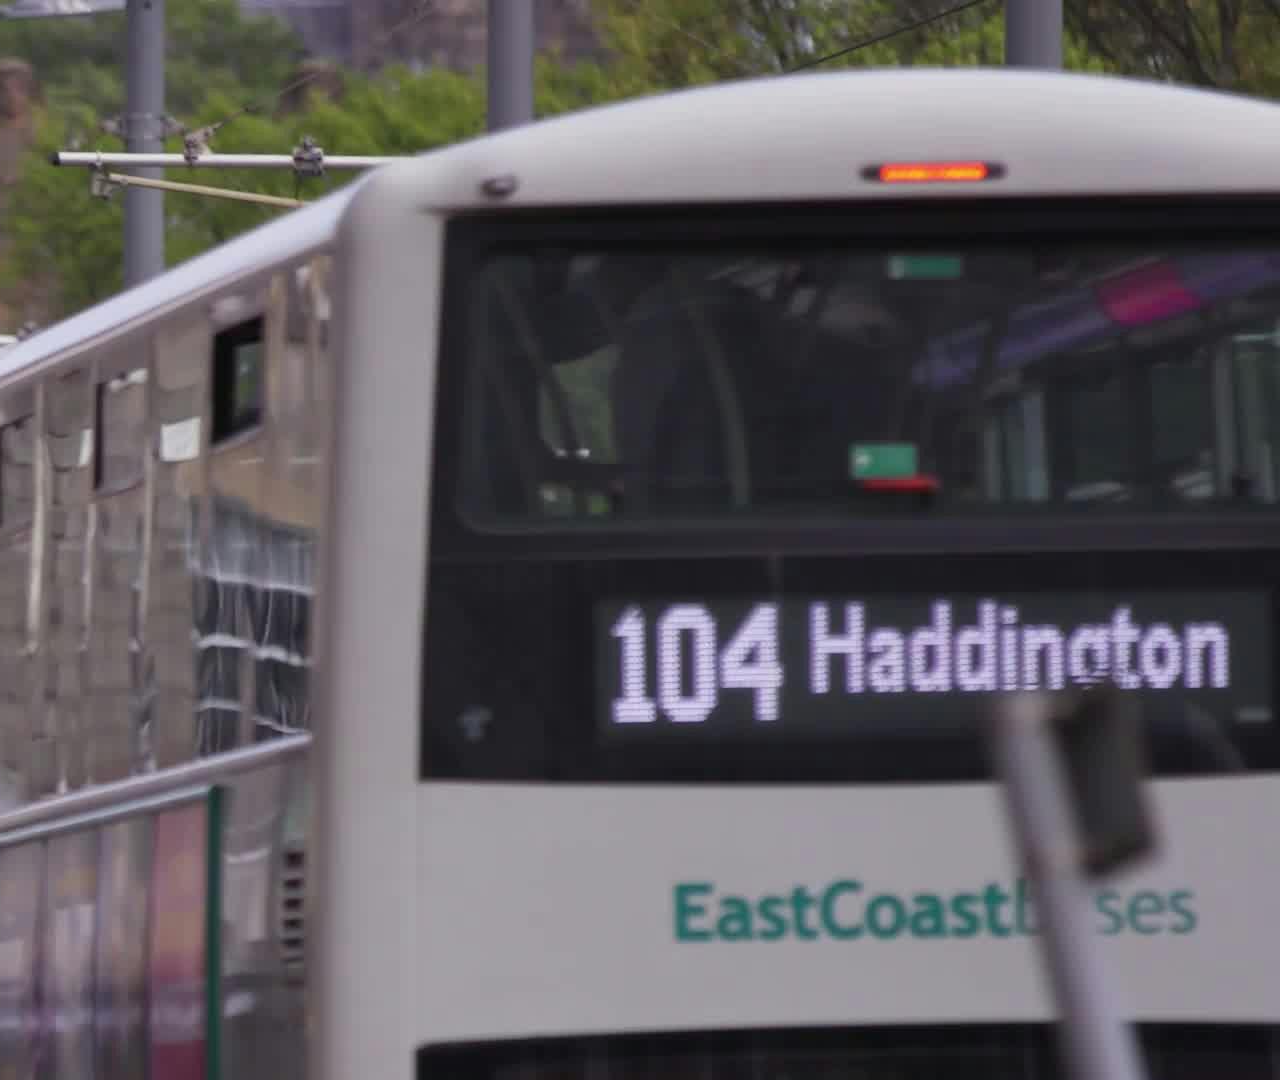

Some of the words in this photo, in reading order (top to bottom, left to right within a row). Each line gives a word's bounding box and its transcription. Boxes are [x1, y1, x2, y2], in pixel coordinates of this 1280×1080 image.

[610, 604, 783, 723] 104
[809, 600, 1230, 693] Haddington
[672, 880, 1198, 943] EastCoastbses
